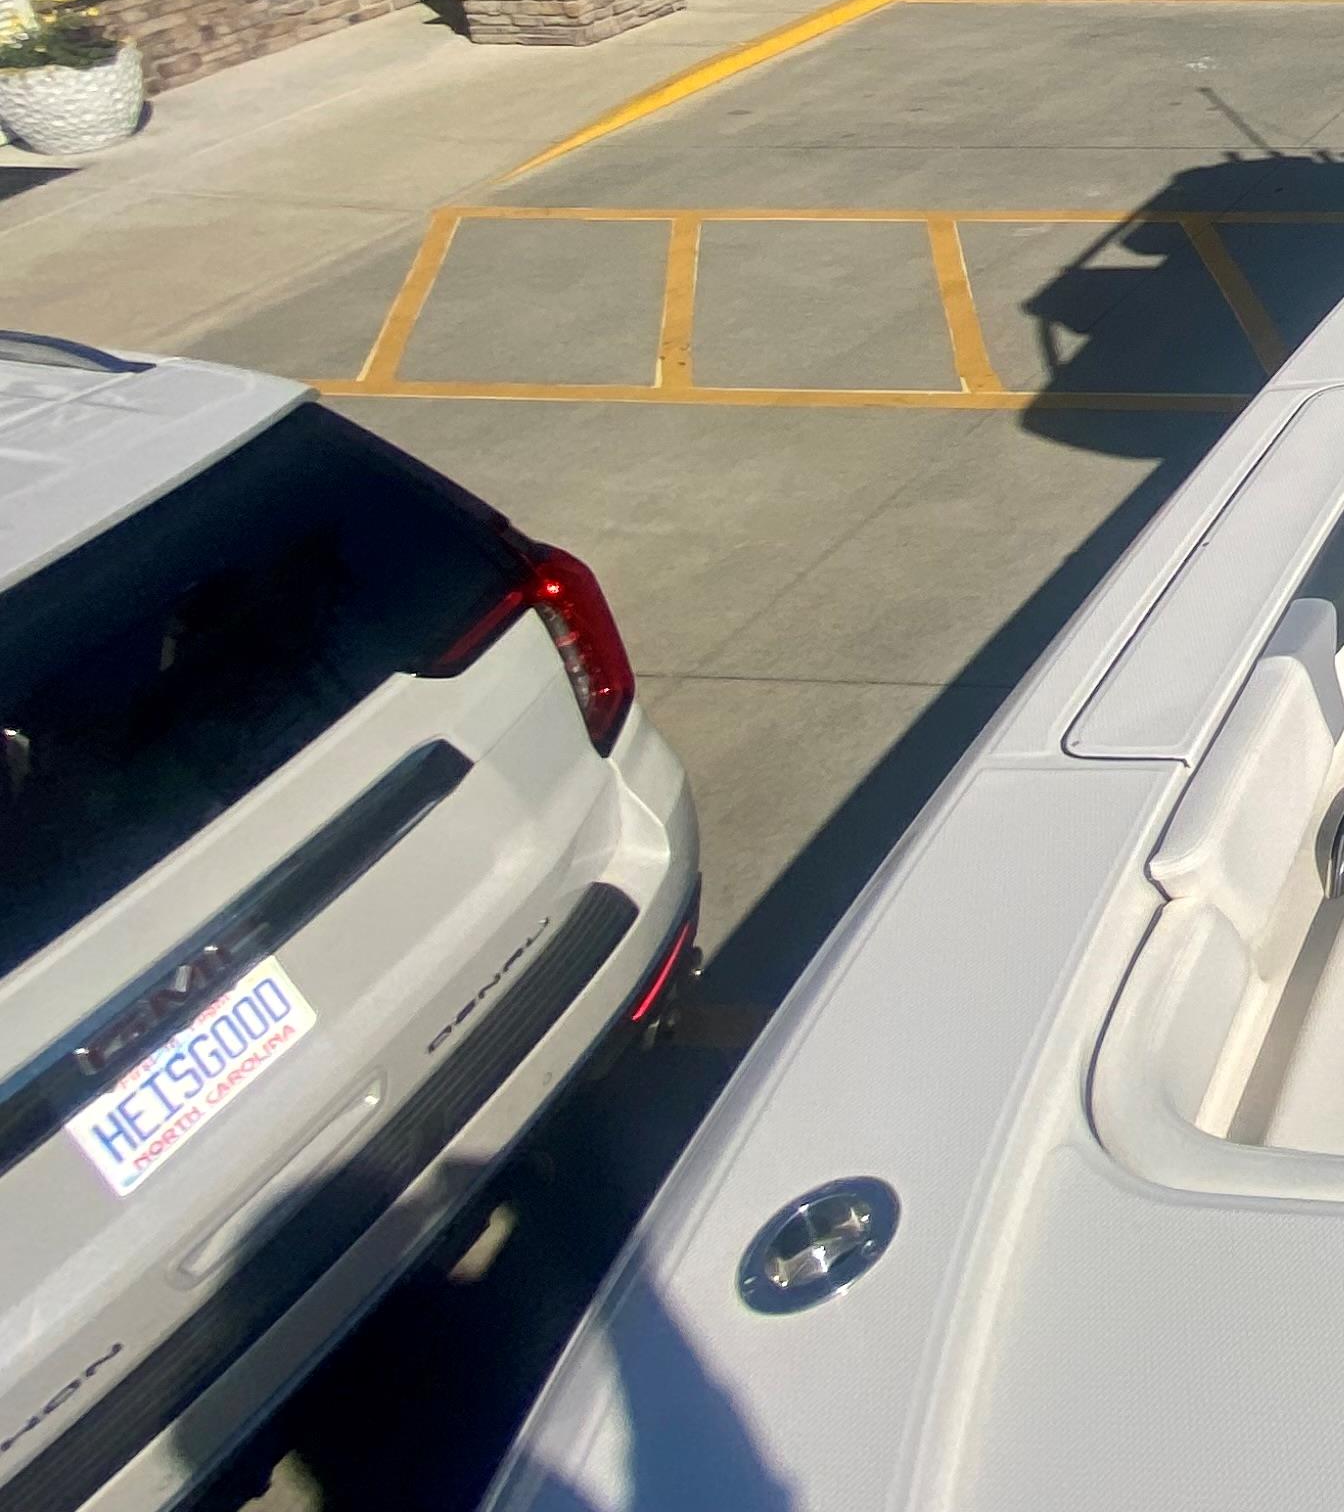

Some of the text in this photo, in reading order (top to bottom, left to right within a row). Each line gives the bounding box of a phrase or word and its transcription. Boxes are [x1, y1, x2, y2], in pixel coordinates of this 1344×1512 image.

[91, 977, 292, 1164] HEISGOOD
[132, 1105, 207, 1171] NORTH
[205, 1023, 297, 1105] CAROLINA
